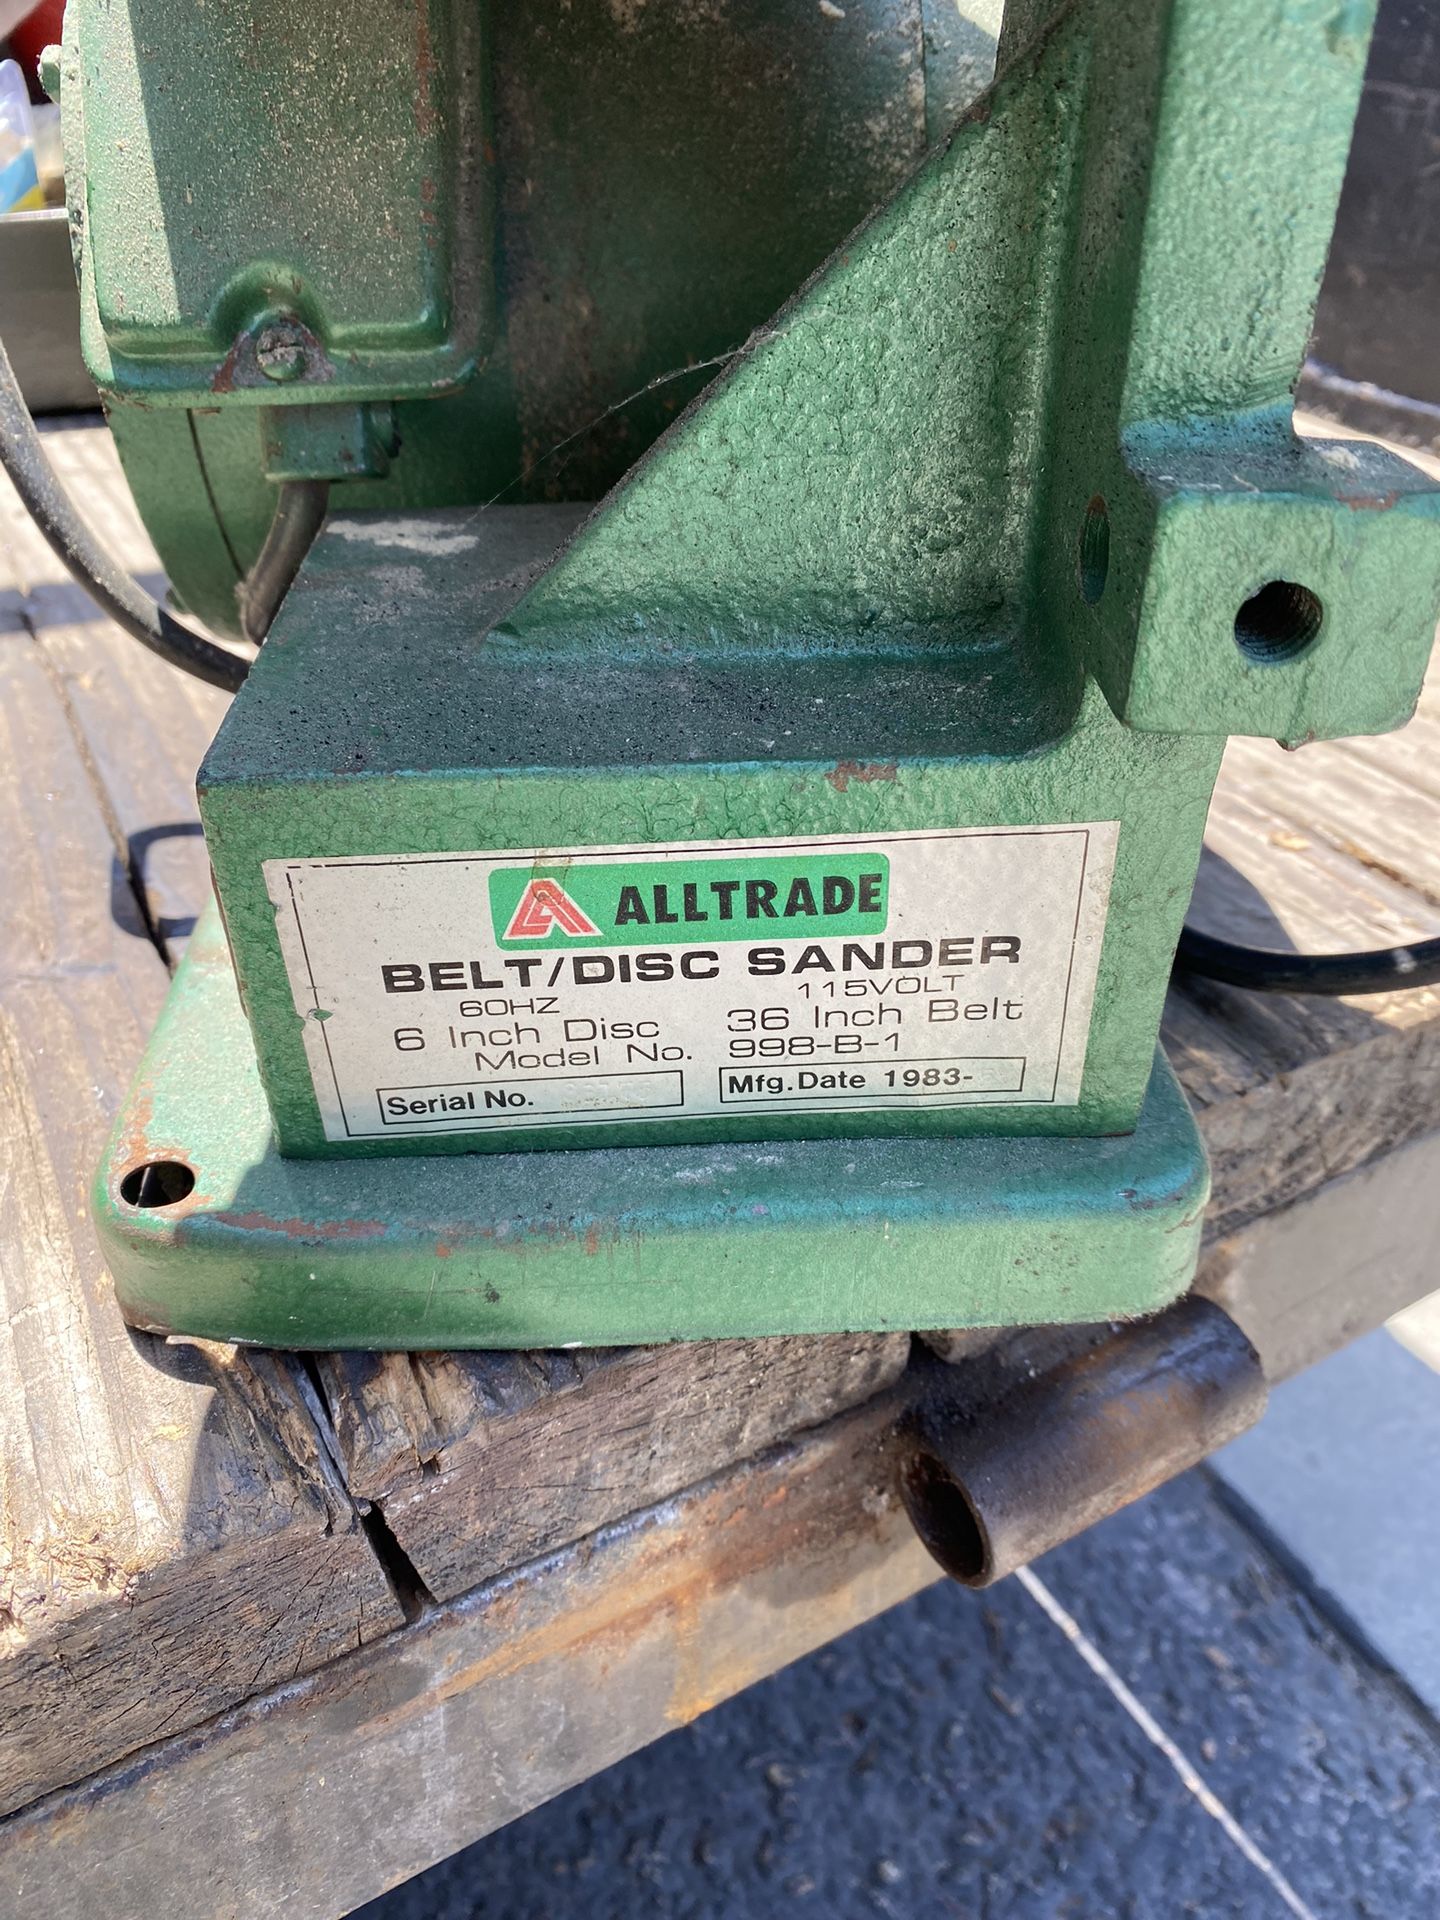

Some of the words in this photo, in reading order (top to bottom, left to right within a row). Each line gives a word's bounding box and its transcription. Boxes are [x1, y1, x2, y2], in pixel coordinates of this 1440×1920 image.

[614, 873, 883, 926] ALLTRADE
[380, 950, 720, 994] BELT/DISC
[747, 936, 1021, 976] SANDER
[459, 996, 560, 1018] 60HZ
[797, 974, 964, 999] 115VOLT
[393, 1027, 426, 1052] 6
[448, 1022, 541, 1049] Inch
[563, 1017, 660, 1042] Disc
[727, 1007, 790, 1032] 36
[814, 1002, 902, 1029] Inch
[928, 996, 1023, 1022] Belt
[474, 1045, 599, 1071] Model
[626, 1042, 692, 1063] No.
[728, 1032, 899, 1058] 998-B-1
[884, 1068, 973, 1087] 1983-
[386, 1091, 476, 1116] Serial
[484, 1089, 534, 1109] No.
